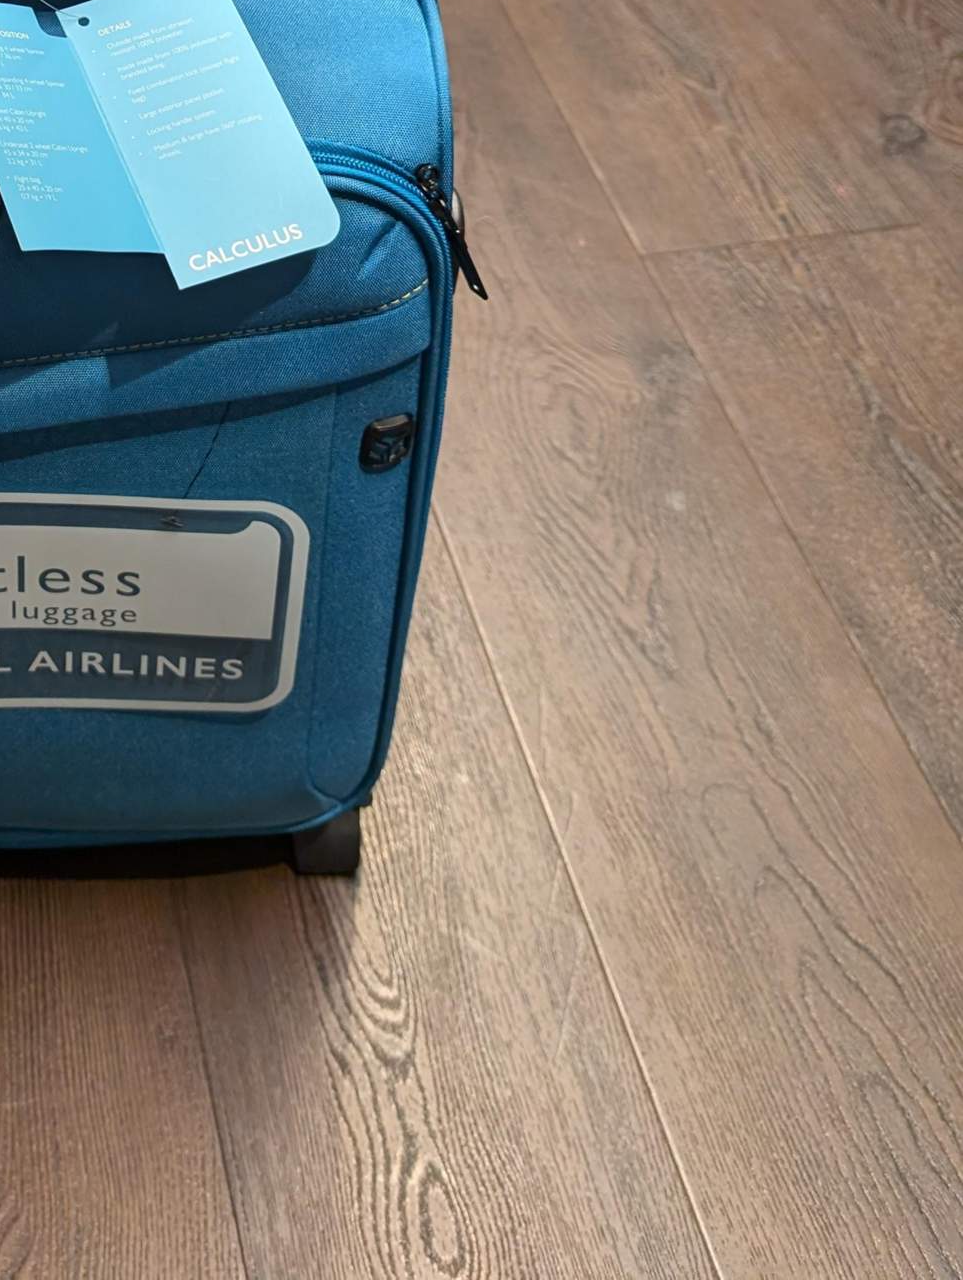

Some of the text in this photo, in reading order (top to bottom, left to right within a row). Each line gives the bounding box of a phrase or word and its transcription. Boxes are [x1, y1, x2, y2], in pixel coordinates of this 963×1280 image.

[97, 20, 131, 37] DETAILS
[188, 223, 303, 271] CALCULUS
[12, 600, 137, 627] luggage
[28, 650, 244, 680] AIRLINES
